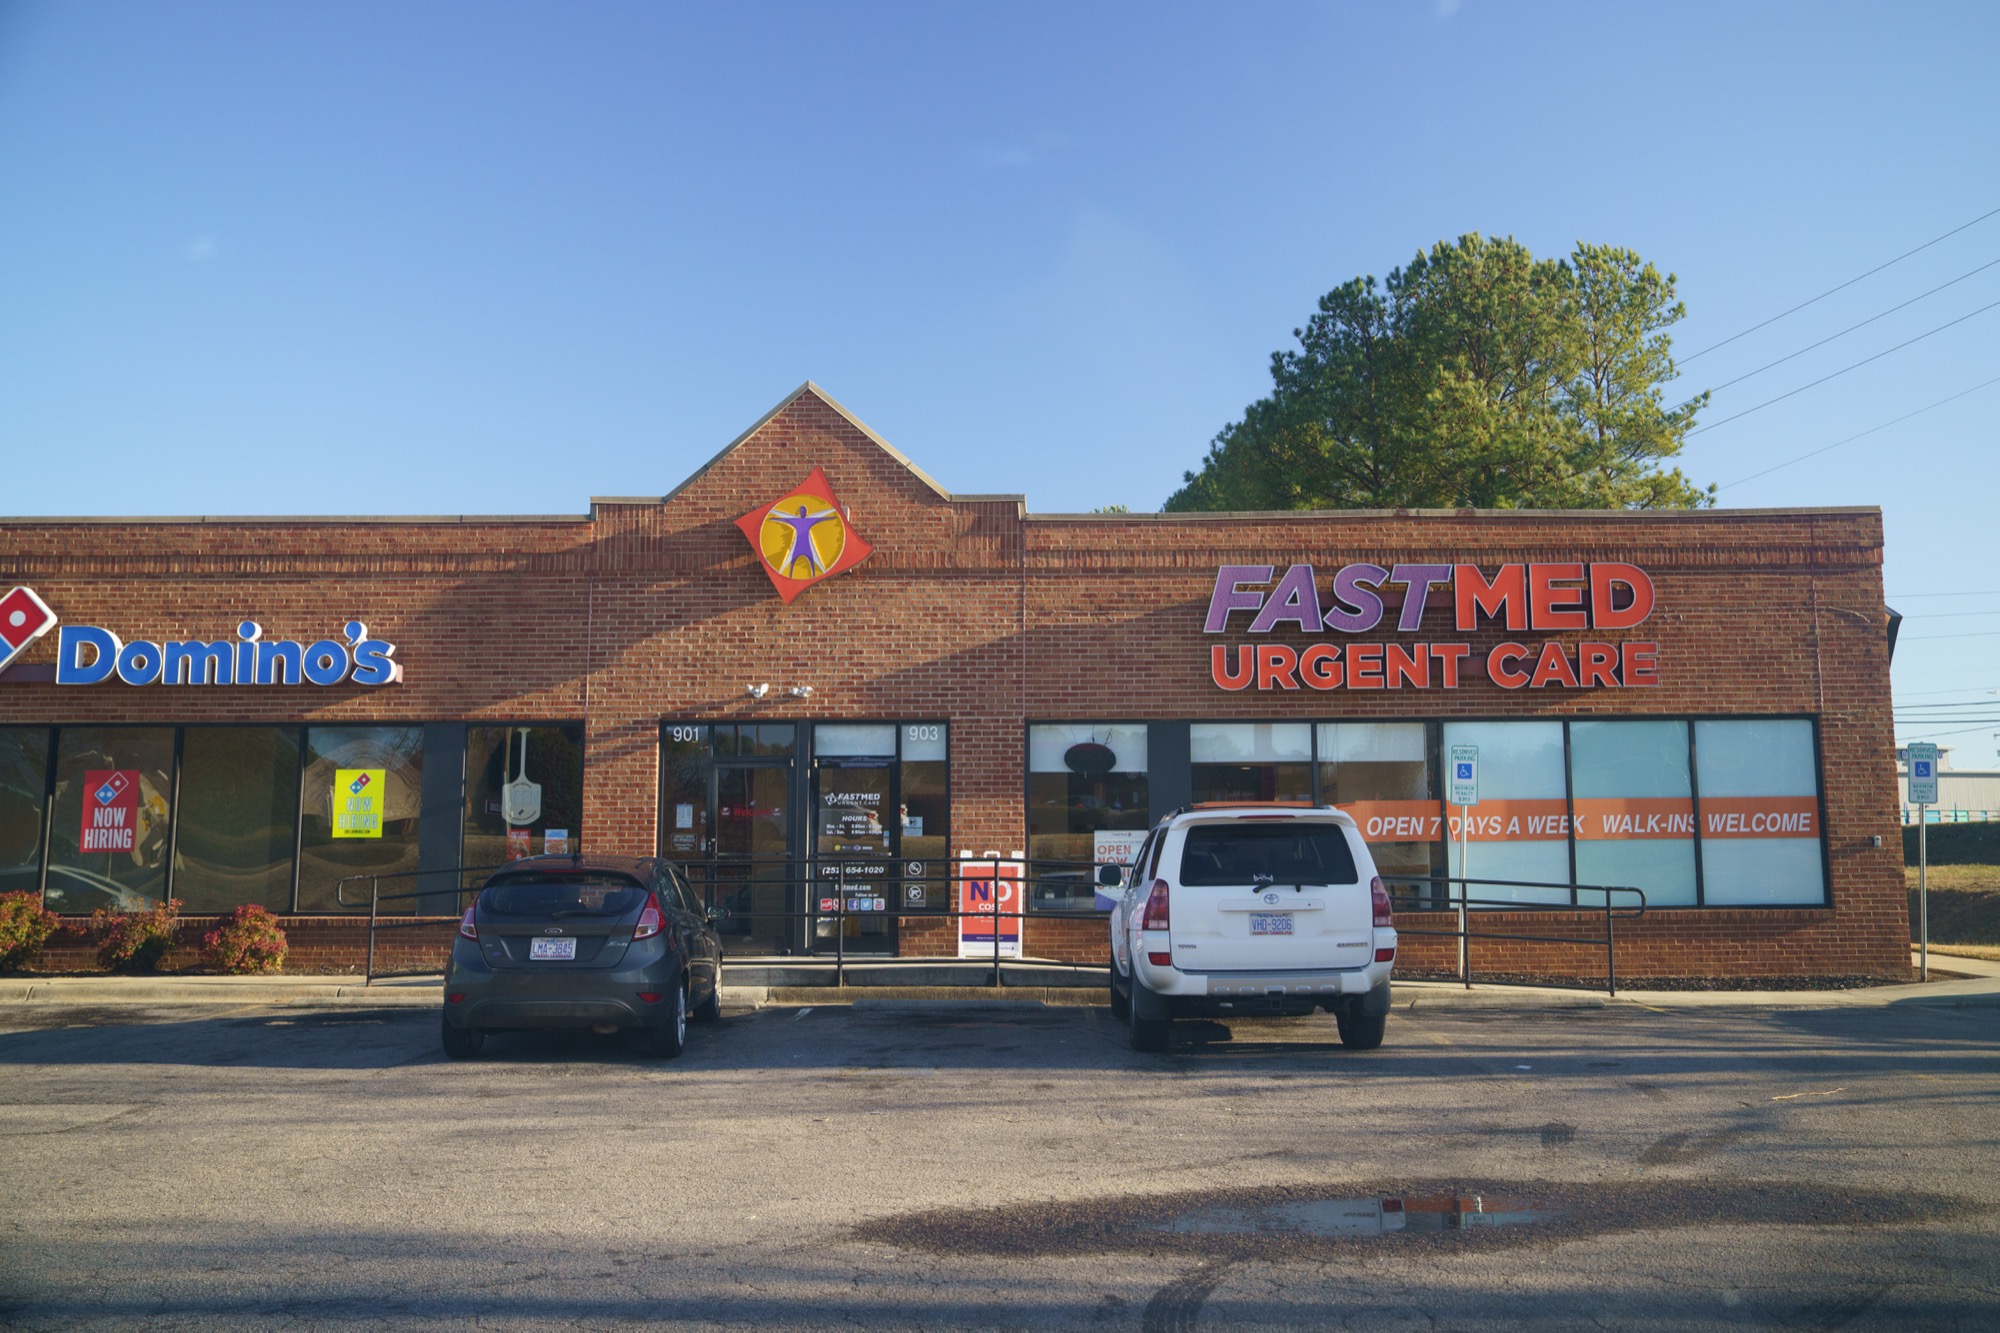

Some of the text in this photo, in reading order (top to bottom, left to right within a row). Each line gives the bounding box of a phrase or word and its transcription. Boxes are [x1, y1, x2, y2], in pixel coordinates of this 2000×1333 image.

[1203, 562, 1656, 633] FASTMED
[56, 620, 398, 687] Domino's
[1211, 642, 1660, 690] URGENT CARE
[673, 727, 699, 742] 901
[909, 726, 938, 741] 903
[346, 796, 373, 812] NOW
[837, 793, 881, 801] FASTMED
[93, 807, 127, 828] NOW
[338, 813, 378, 829] HIRING
[1366, 812, 1811, 835] OPEN 7 DAYS A WEEK WALK-INS WELCOME
[83, 828, 133, 849] HIRING
[1097, 845, 1131, 855] OPEN
[845, 866, 884, 874] 654-1020
